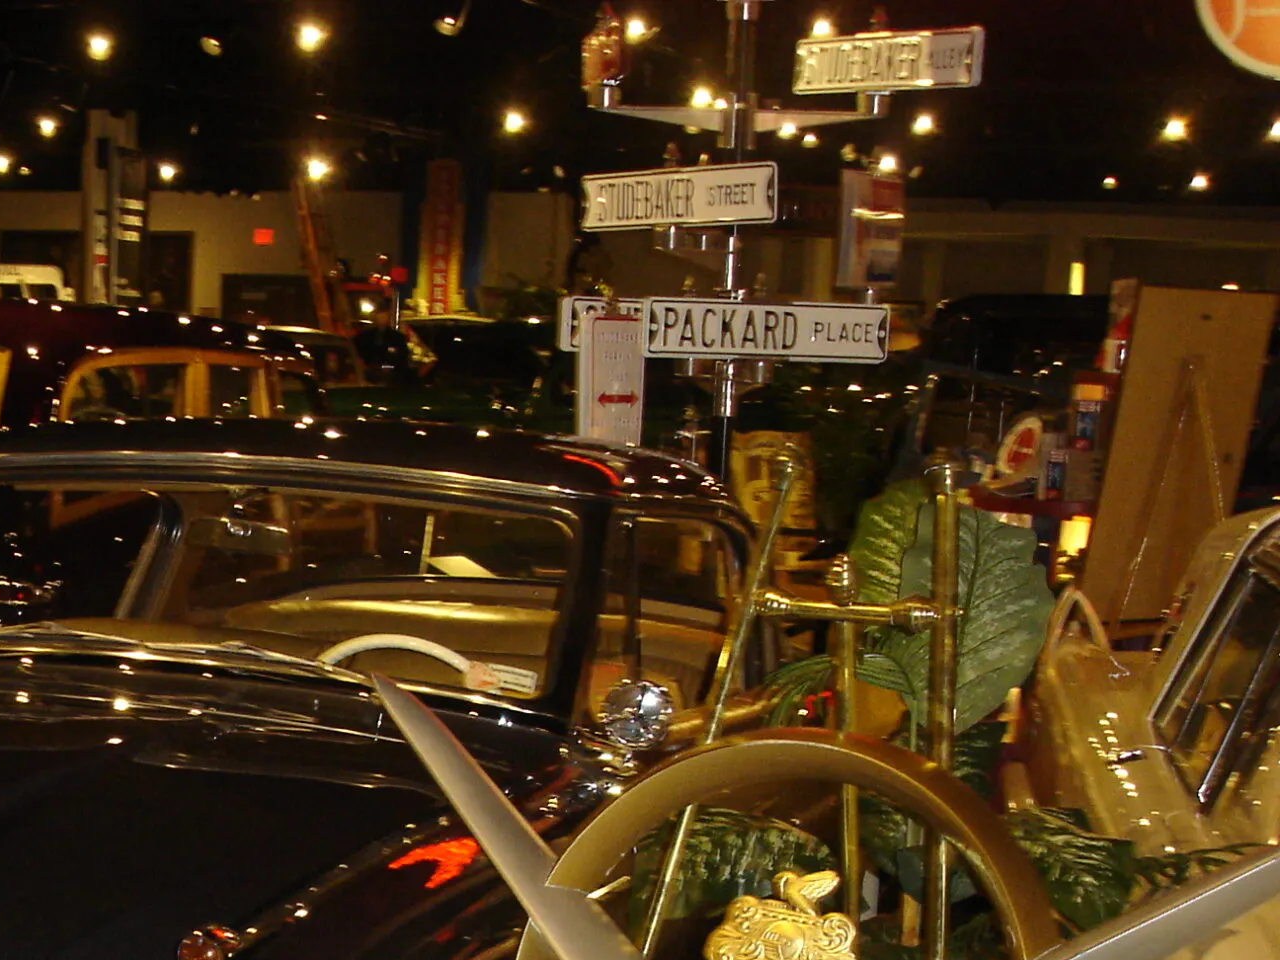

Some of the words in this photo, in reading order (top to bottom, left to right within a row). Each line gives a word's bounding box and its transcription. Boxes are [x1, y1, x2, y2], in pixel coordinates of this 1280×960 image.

[803, 35, 920, 85] STUDEBAKER
[596, 177, 695, 222] STUDEBAKER
[707, 182, 757, 207] STREET
[661, 306, 798, 351] PACKARD
[814, 321, 874, 344] PLACE
